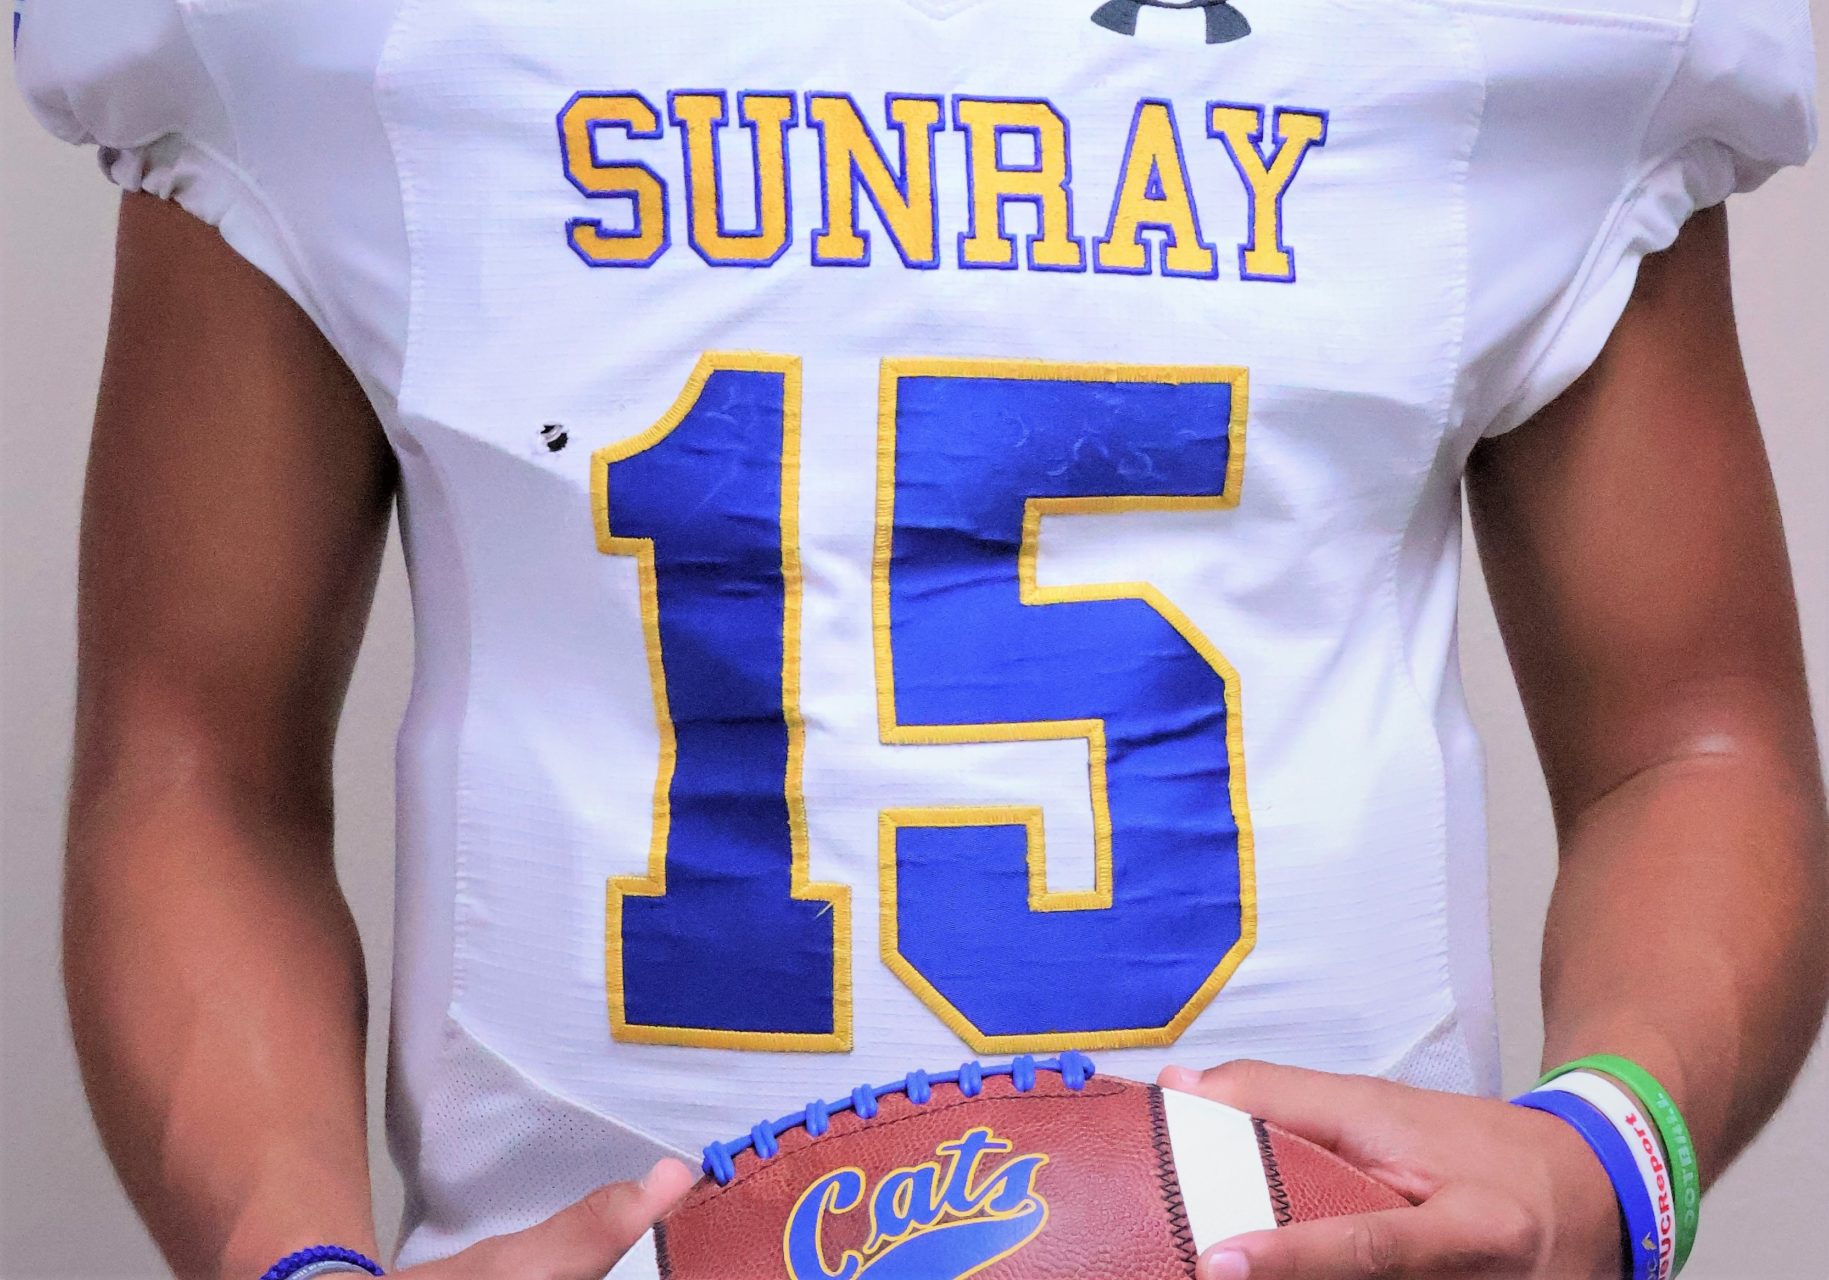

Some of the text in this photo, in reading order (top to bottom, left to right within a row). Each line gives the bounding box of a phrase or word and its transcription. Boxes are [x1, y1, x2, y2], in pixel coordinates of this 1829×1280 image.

[556, 88, 1329, 283] SUNRAY
[591, 350, 1258, 1055] 15
[783, 1126, 1050, 1280] Cats
[1656, 1092, 1696, 1227] OOTBALL
